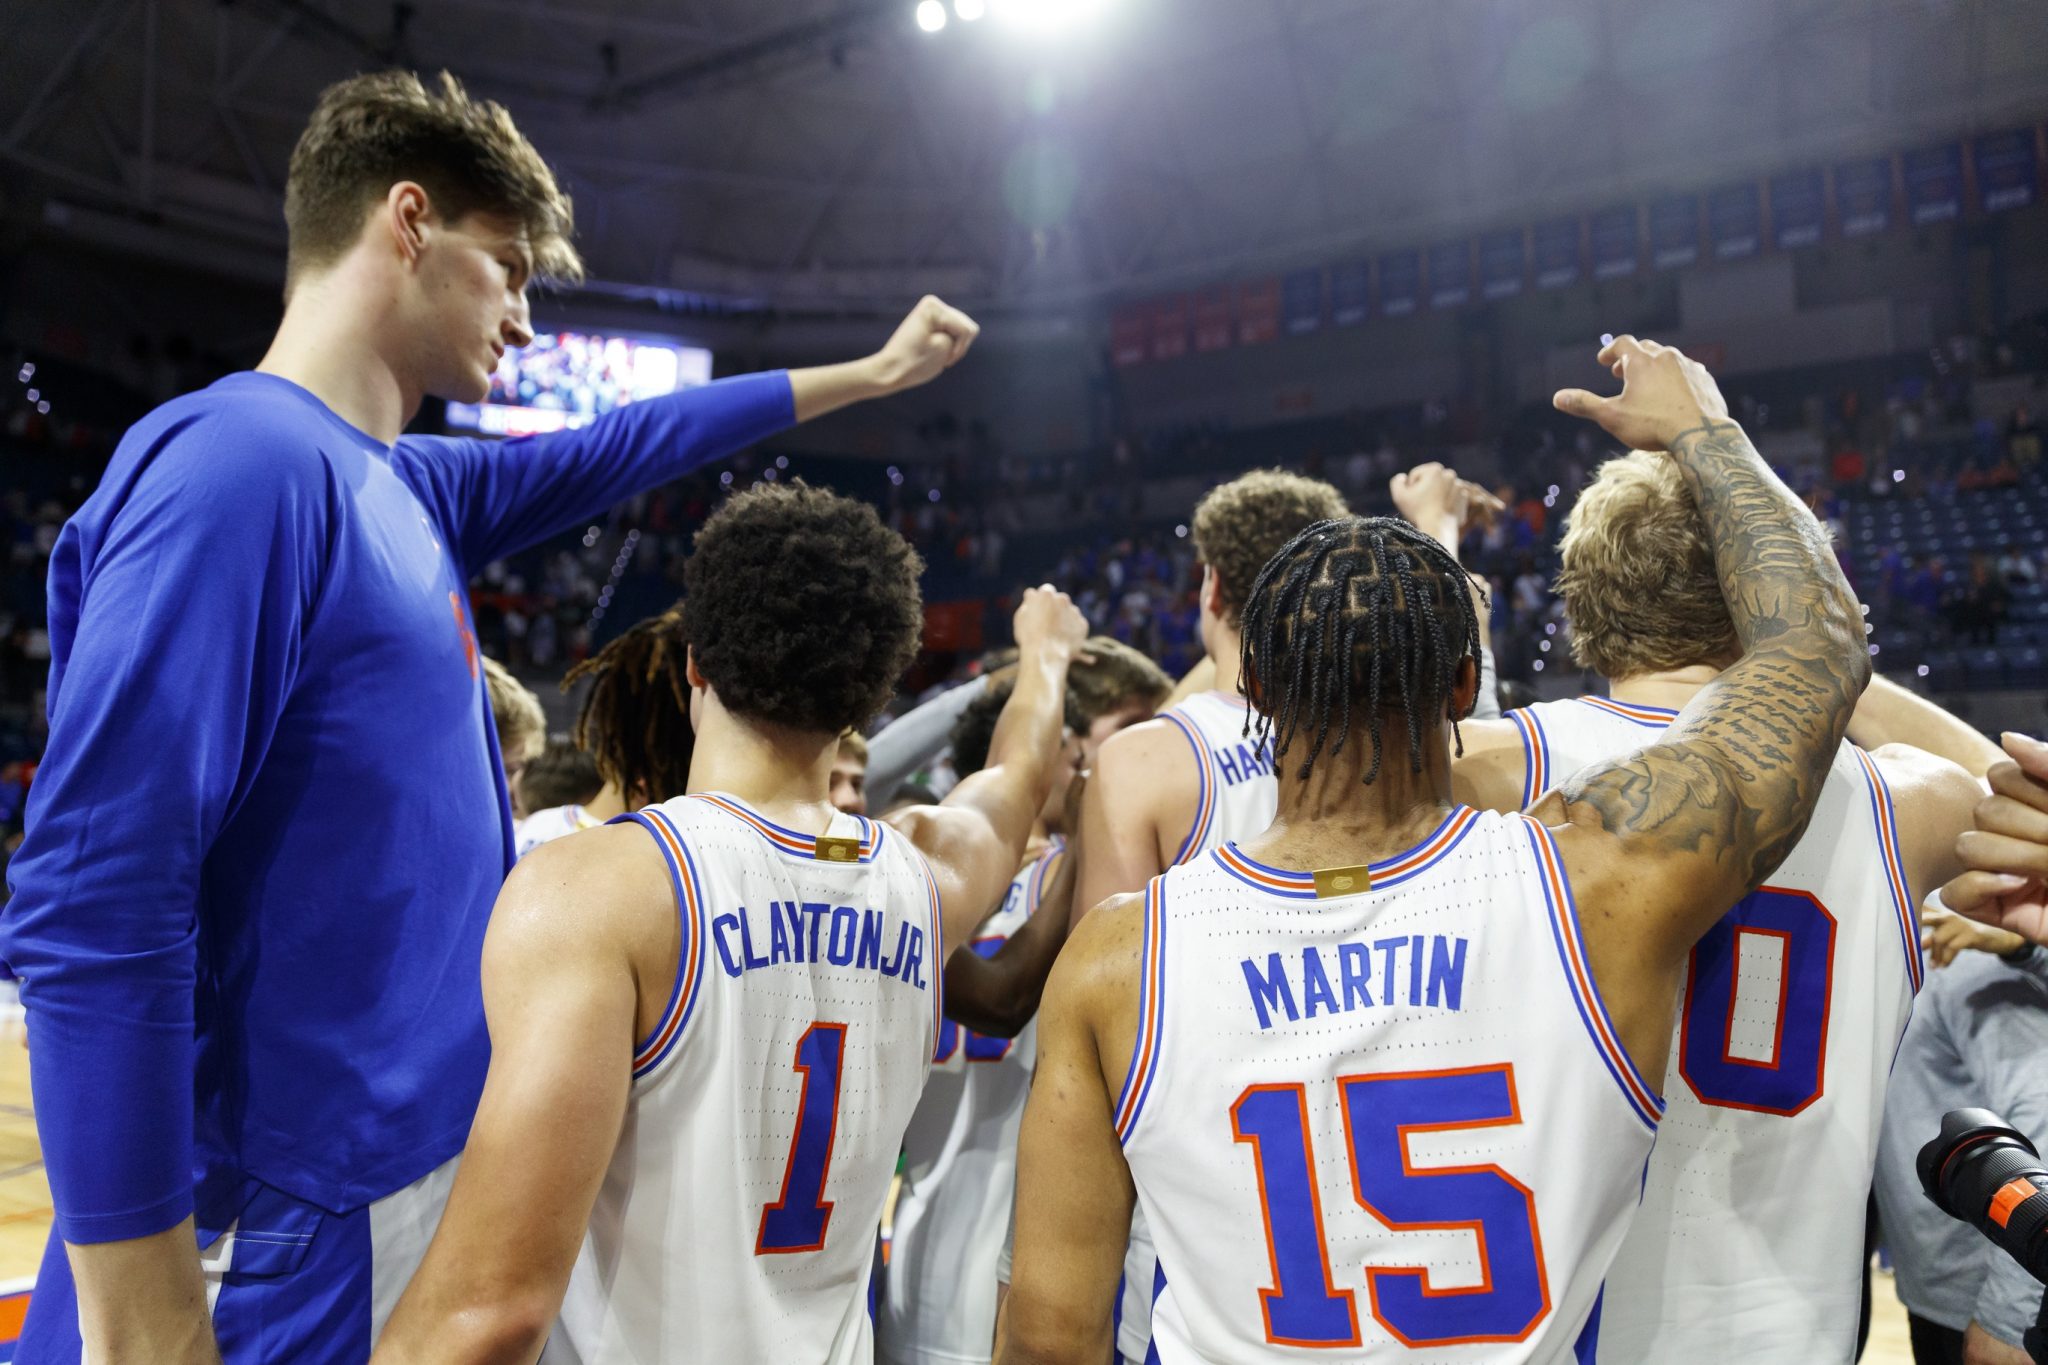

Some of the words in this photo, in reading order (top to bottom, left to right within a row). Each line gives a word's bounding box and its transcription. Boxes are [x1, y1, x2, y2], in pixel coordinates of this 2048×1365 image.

[712, 901, 883, 978] CLAYTON
[880, 920, 927, 990] JR.
[1241, 935, 1468, 1030] MARTIN
[755, 1021, 848, 1256] 1
[1229, 1062, 1552, 1348] 15
